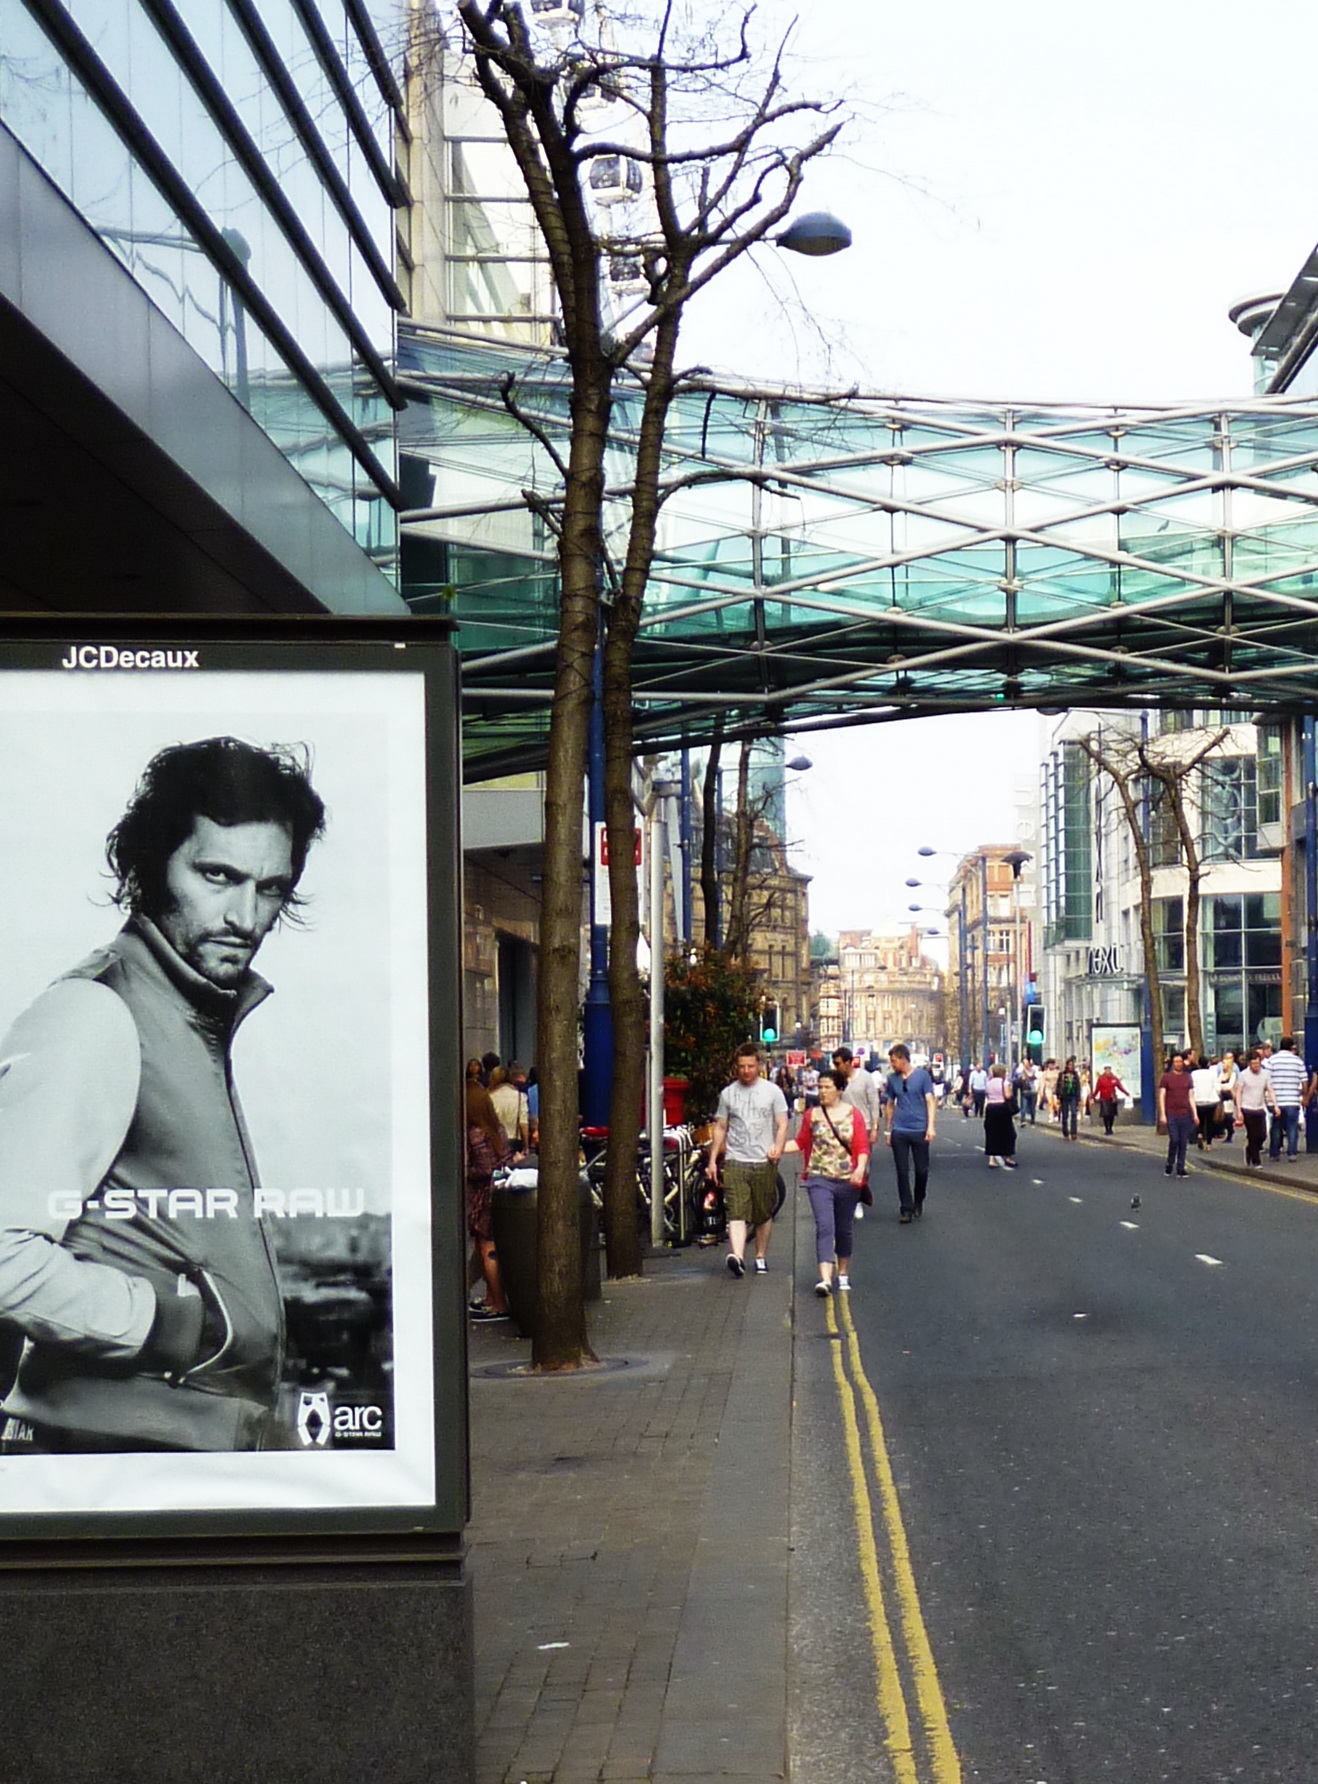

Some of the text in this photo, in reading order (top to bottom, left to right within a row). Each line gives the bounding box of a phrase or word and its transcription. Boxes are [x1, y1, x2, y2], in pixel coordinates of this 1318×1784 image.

[62, 645, 200, 669] JCDecaux
[48, 1188, 365, 1219] G-STAR RAW
[333, 1405, 383, 1430] arc
